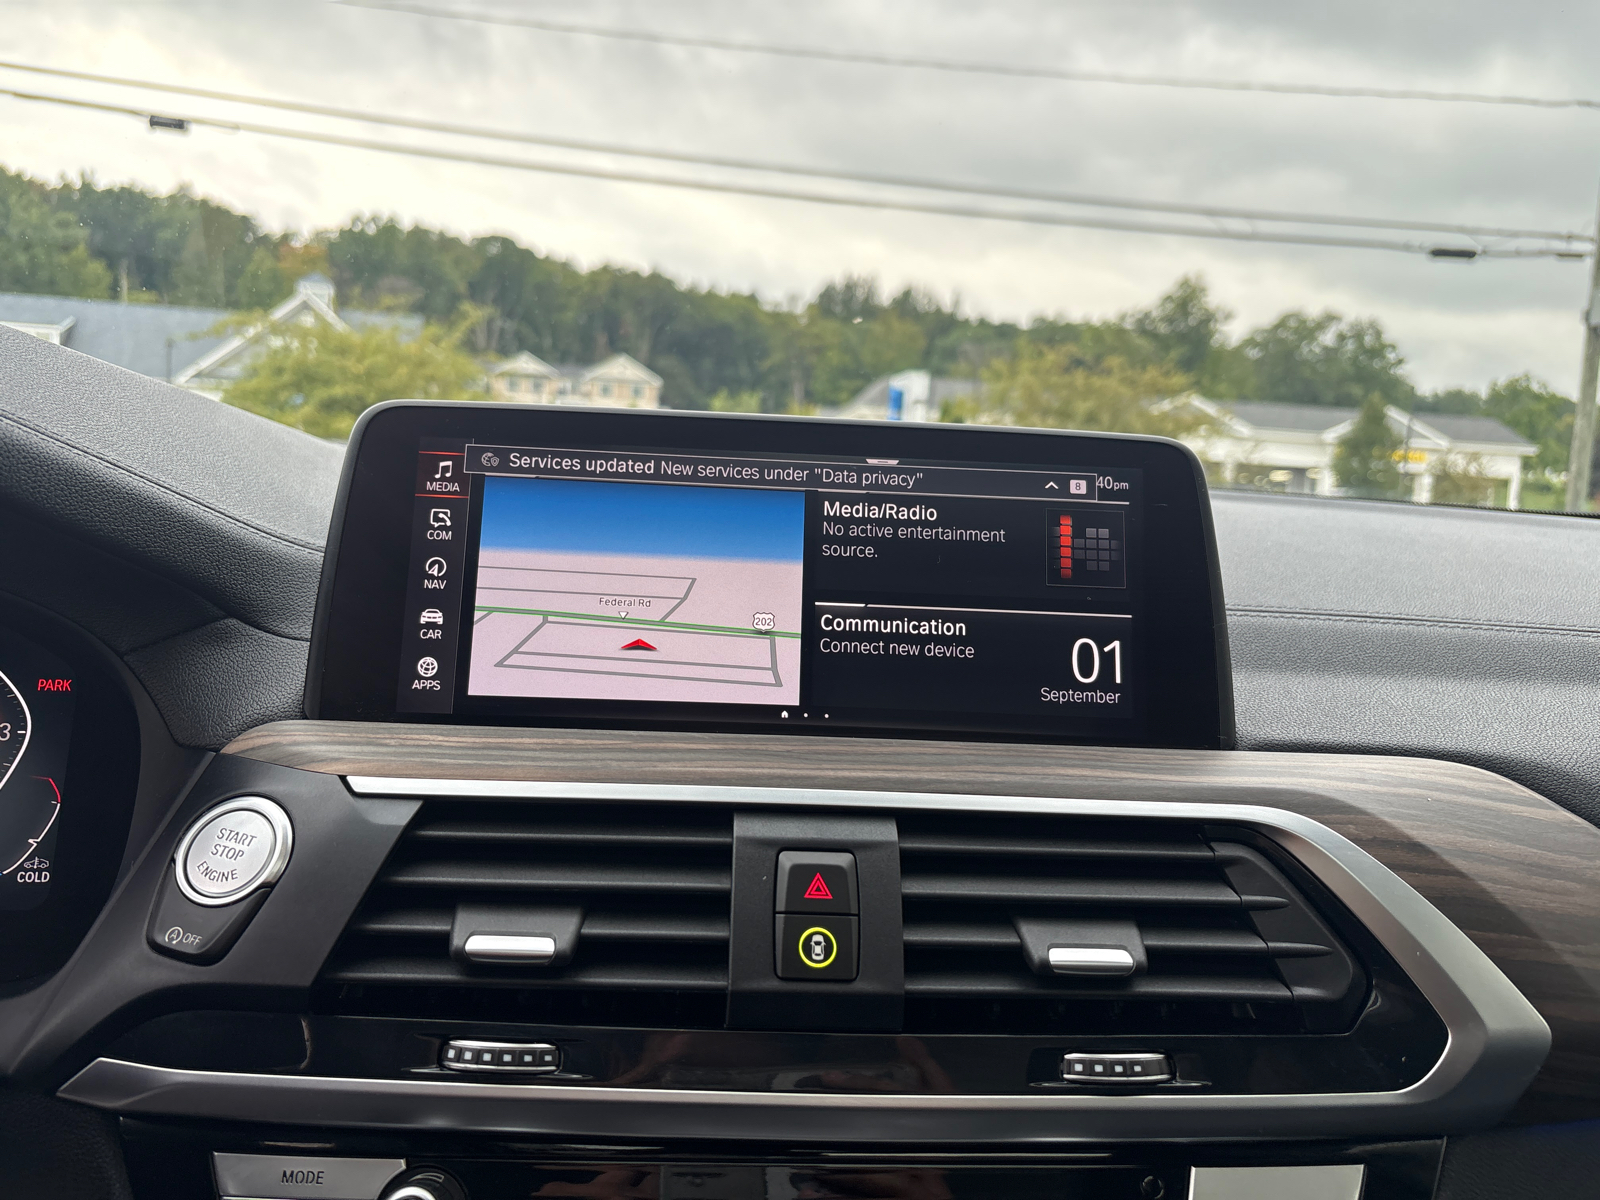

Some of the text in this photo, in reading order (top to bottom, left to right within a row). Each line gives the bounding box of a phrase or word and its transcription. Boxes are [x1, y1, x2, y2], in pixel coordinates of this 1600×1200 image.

[509, 453, 923, 489] Services updated New services under "Data privacy"
[426, 481, 460, 493] MEDIA
[823, 501, 938, 522] Media/Radio
[427, 530, 452, 541] COM
[822, 522, 1006, 543] No active entertainment
[822, 543, 879, 558] source.
[424, 579, 446, 590] NAV
[599, 597, 652, 609] Federal Rd
[755, 617, 773, 627] 202
[820, 614, 967, 636] Communication
[420, 629, 442, 640] CAR
[820, 638, 975, 658] Connect new device
[1071, 638, 1123, 684] 01
[37, 679, 72, 692] PARK
[412, 679, 441, 691] APPS
[1040, 687, 1121, 704] September
[0, 723, 11, 741] 3
[216, 828, 257, 847] START
[210, 843, 245, 860] STOP
[17, 871, 50, 883] COLD
[196, 860, 238, 882] ENGINE
[183, 933, 203, 946] OFF
[281, 1170, 325, 1185] MODE
